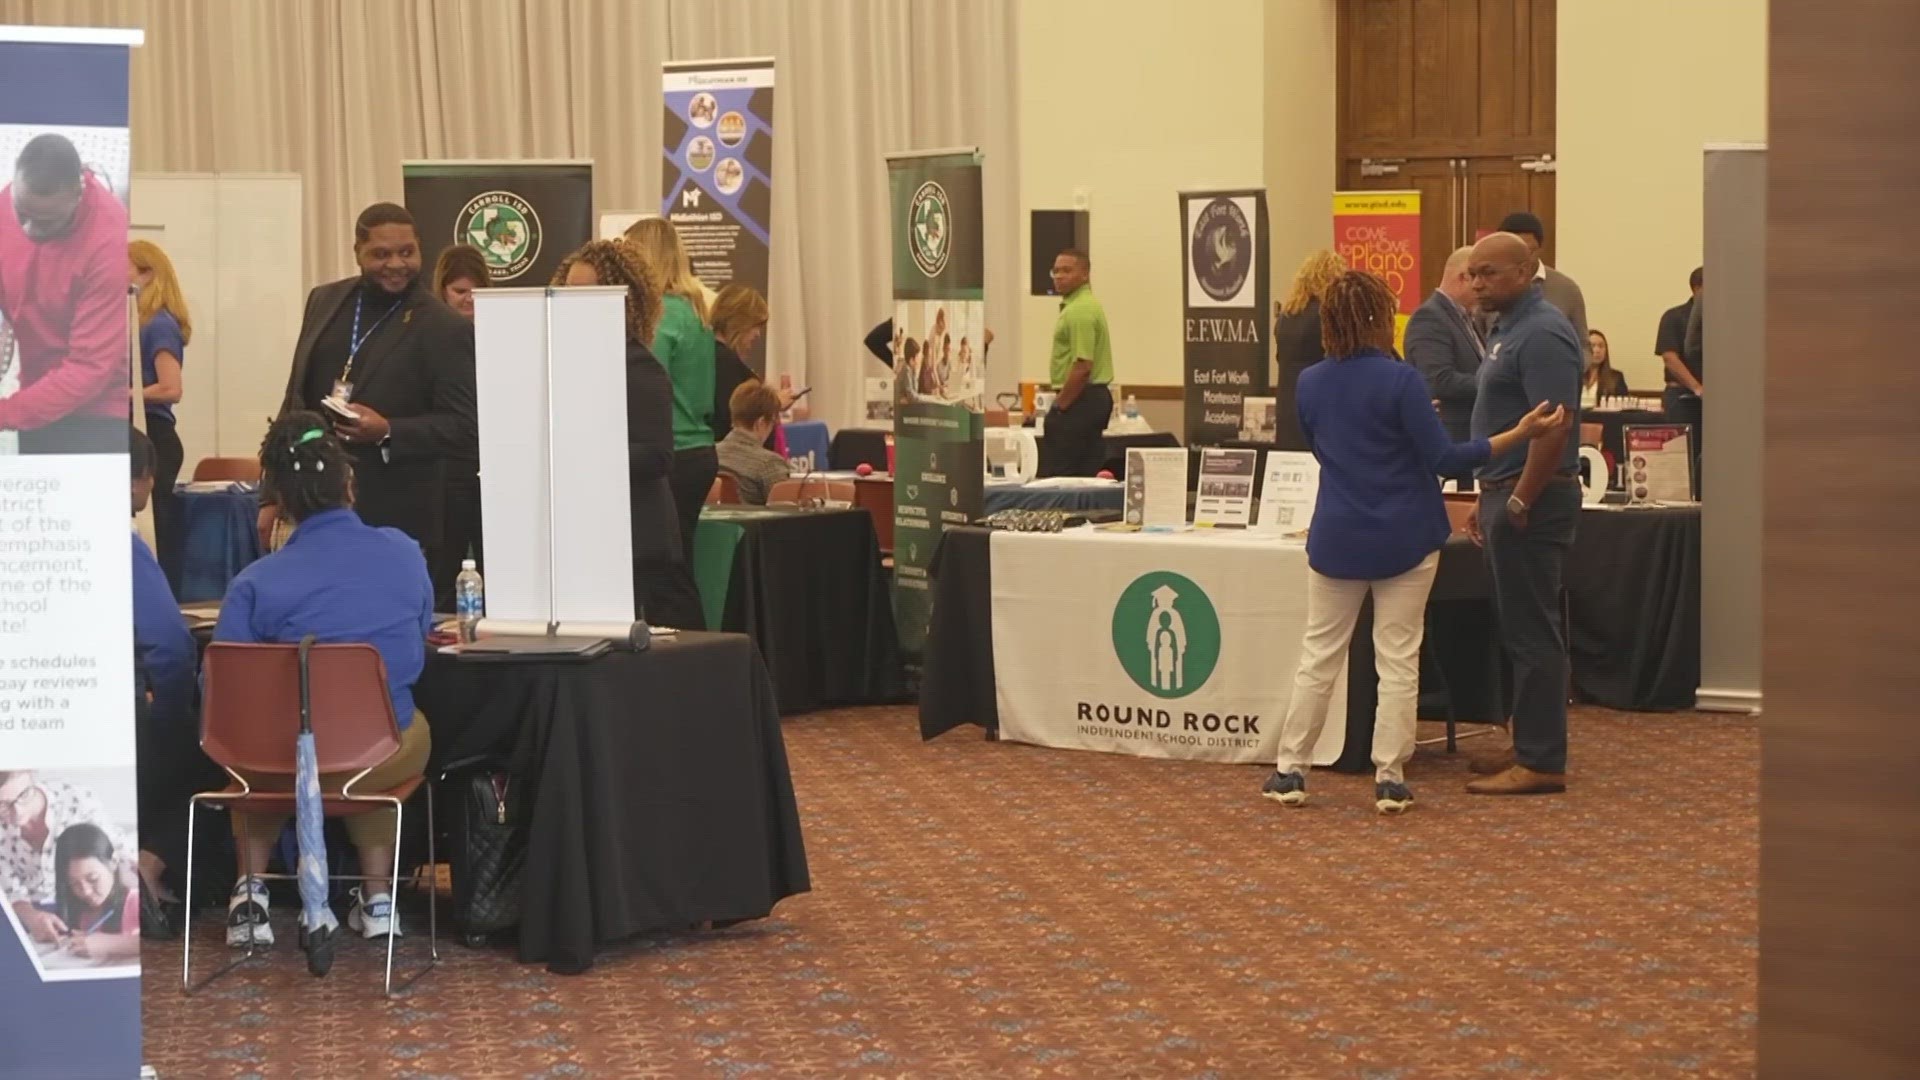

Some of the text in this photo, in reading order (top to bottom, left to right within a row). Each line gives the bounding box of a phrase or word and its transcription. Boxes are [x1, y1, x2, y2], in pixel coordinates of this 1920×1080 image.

[468, 195, 529, 215] CARROLL ISD
[1210, 204, 1227, 218] Fort
[1345, 226, 1387, 241] COME
[1369, 239, 1409, 253] HOME
[1352, 242, 1415, 271] Plano
[1194, 369, 1250, 385] East Fort Worth
[1204, 410, 1242, 428] Academy
[11, 516, 32, 532] of
[40, 516, 72, 532] the
[32, 577, 51, 592] of
[59, 577, 92, 592] the
[0, 597, 48, 613] hool
[10, 654, 97, 669] schedules
[33, 676, 98, 689] reviews
[18, 696, 55, 709] with
[60, 698, 70, 709] a
[21, 717, 65, 730] team
[1078, 702, 1261, 735] ROUND ROCK
[1077, 724, 1260, 749] INDEPENDENT SCHOOL DISTRICT
